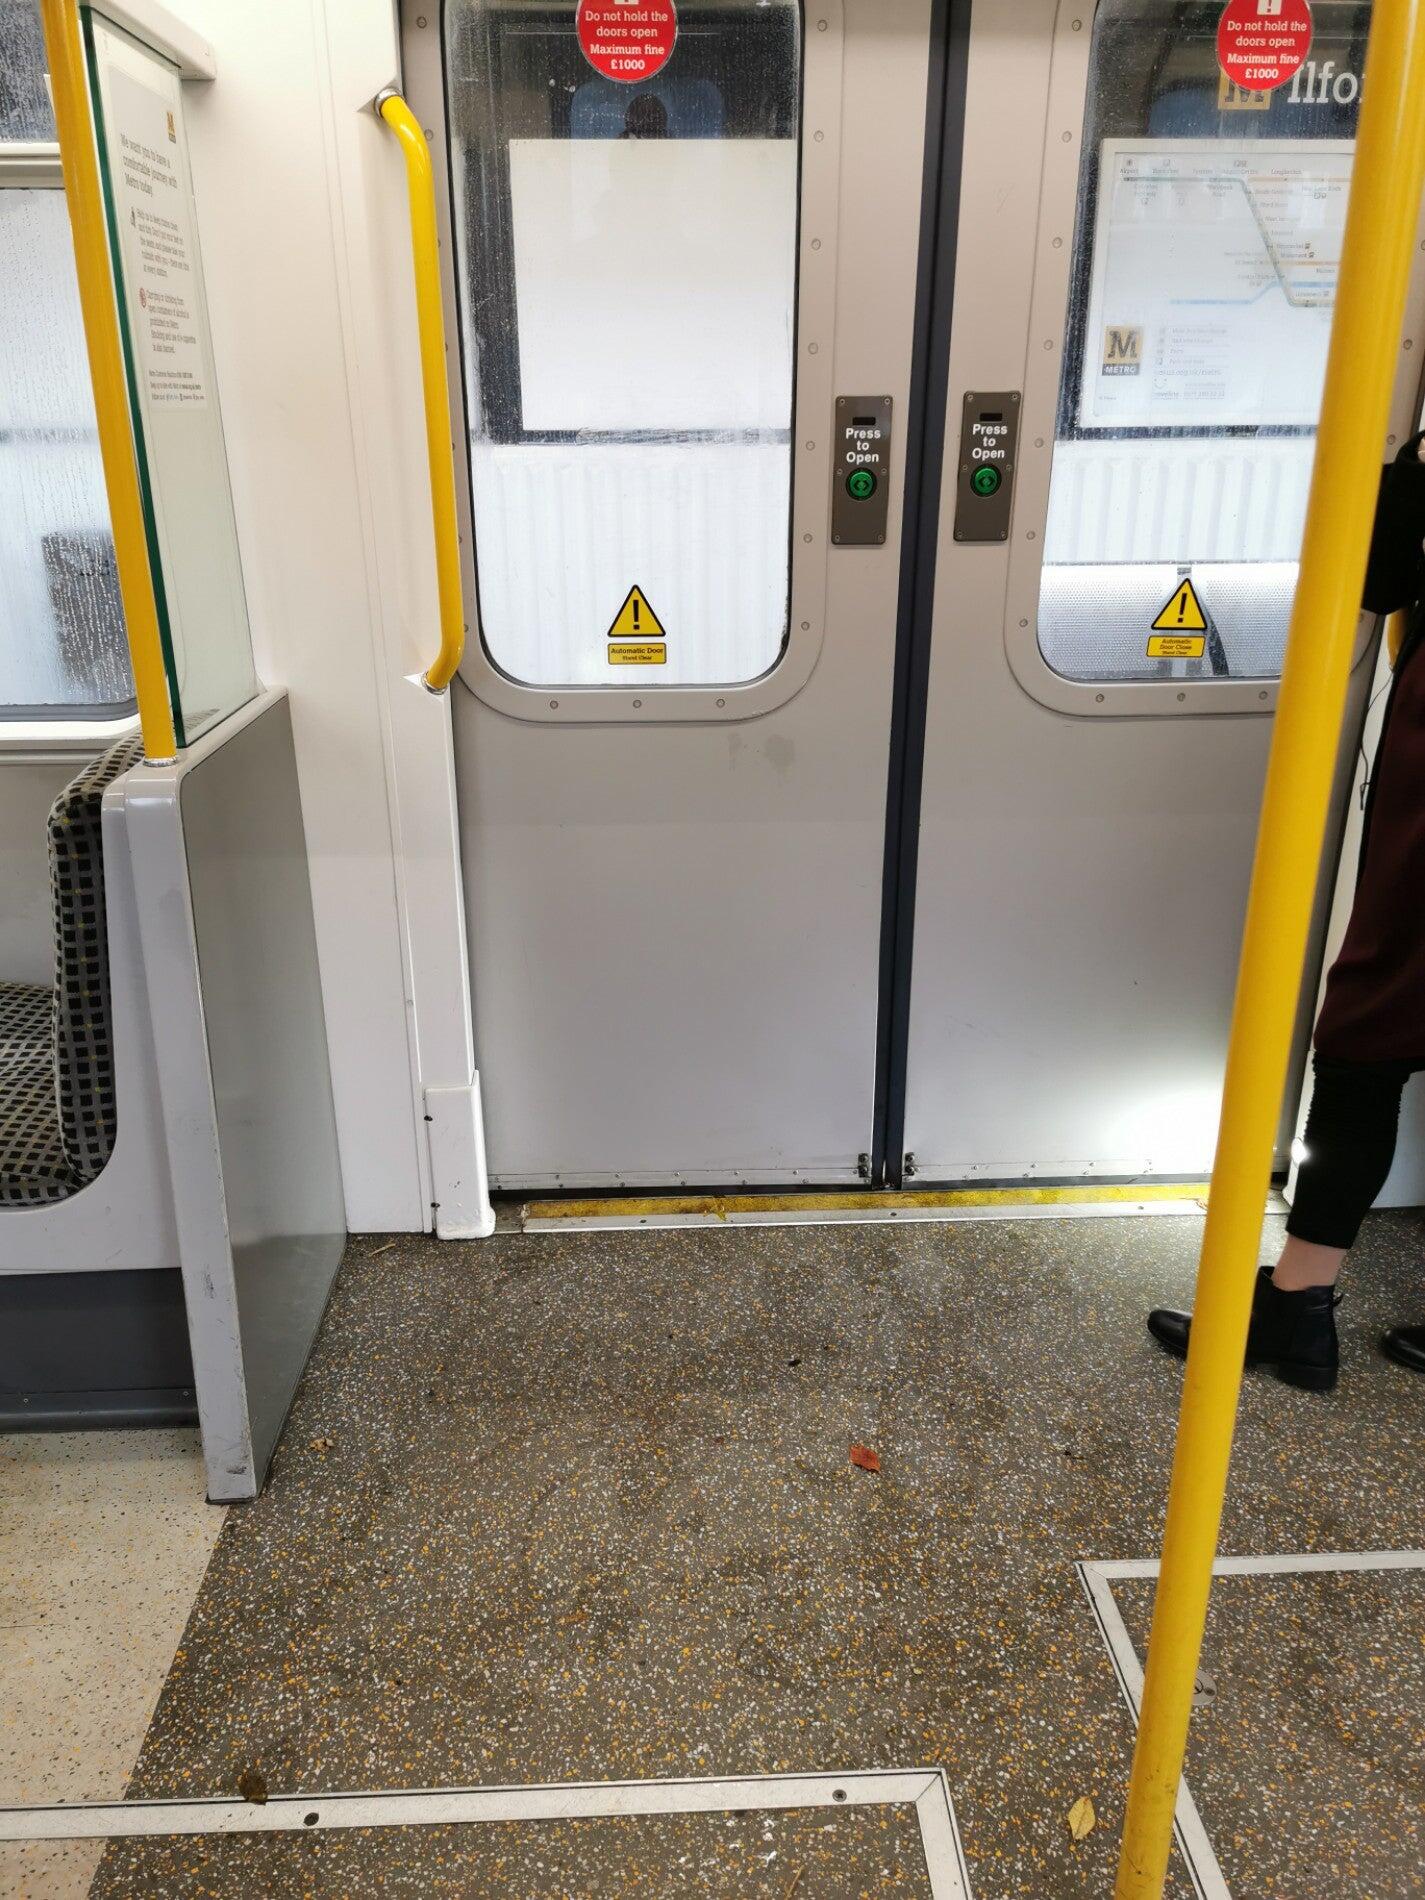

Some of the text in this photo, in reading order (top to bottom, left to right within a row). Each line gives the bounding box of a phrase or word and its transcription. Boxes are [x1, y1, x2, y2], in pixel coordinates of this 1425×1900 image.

[585, 10, 668, 21] Do not hold the
[1227, 21, 1308, 31] Do not hold the
[596, 26, 658, 39] doors open
[1235, 36, 1296, 48] doors open
[590, 43, 665, 54] Maximum fine
[1227, 53, 1300, 64] Maximum fine
[611, 59, 645, 70] £1000
[1245, 68, 1279, 79] £1000
[1287, 61, 1366, 104] Ilfo
[1107, 330, 1138, 358] M
[1104, 366, 1136, 374] METRO
[845, 428, 881, 439] Press
[972, 424, 1008, 435] Press
[856, 441, 870, 451] to
[982, 436, 996, 447] to
[846, 452, 879, 465] Open
[972, 448, 1005, 461] Open
